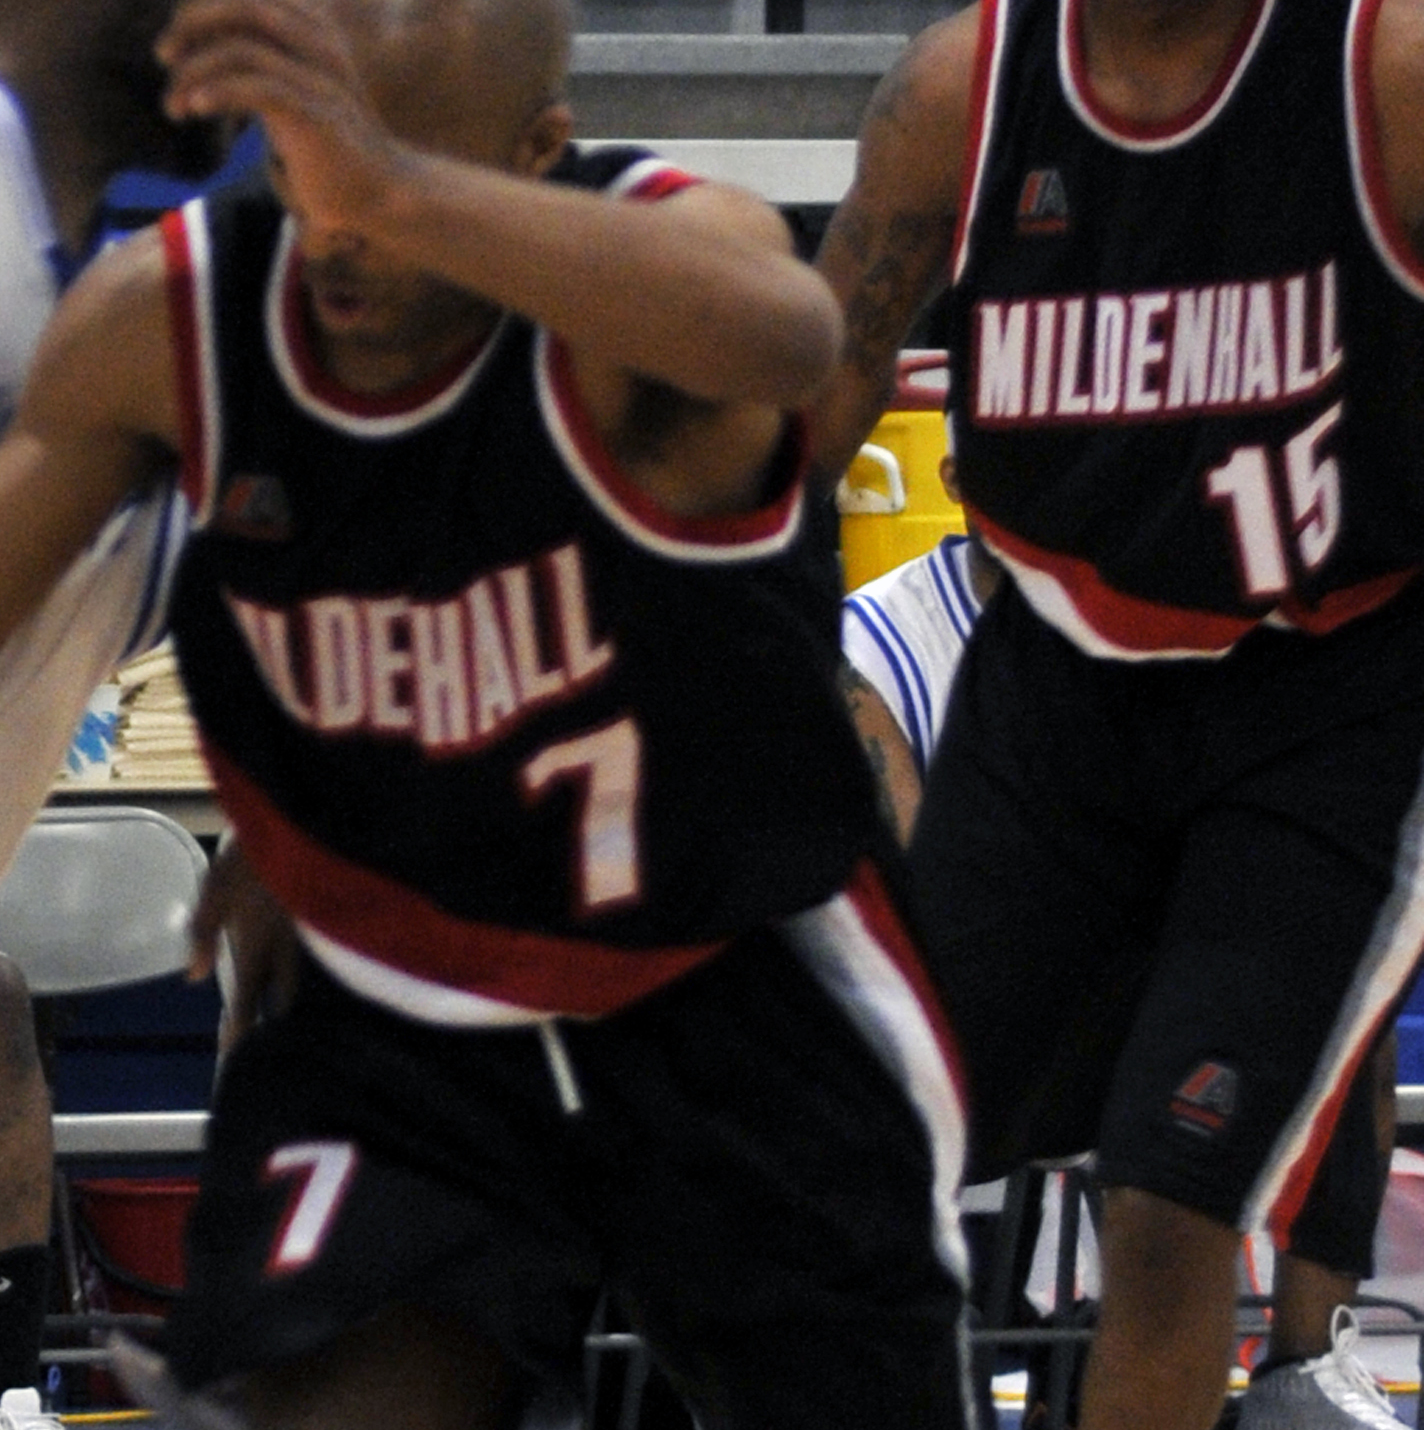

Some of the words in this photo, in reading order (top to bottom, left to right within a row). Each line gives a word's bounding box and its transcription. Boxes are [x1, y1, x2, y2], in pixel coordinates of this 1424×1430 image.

[974, 259, 1345, 423] MILDENHALL
[1206, 400, 1344, 595] 15
[522, 716, 641, 911] 7
[266, 1139, 355, 1269] 7
